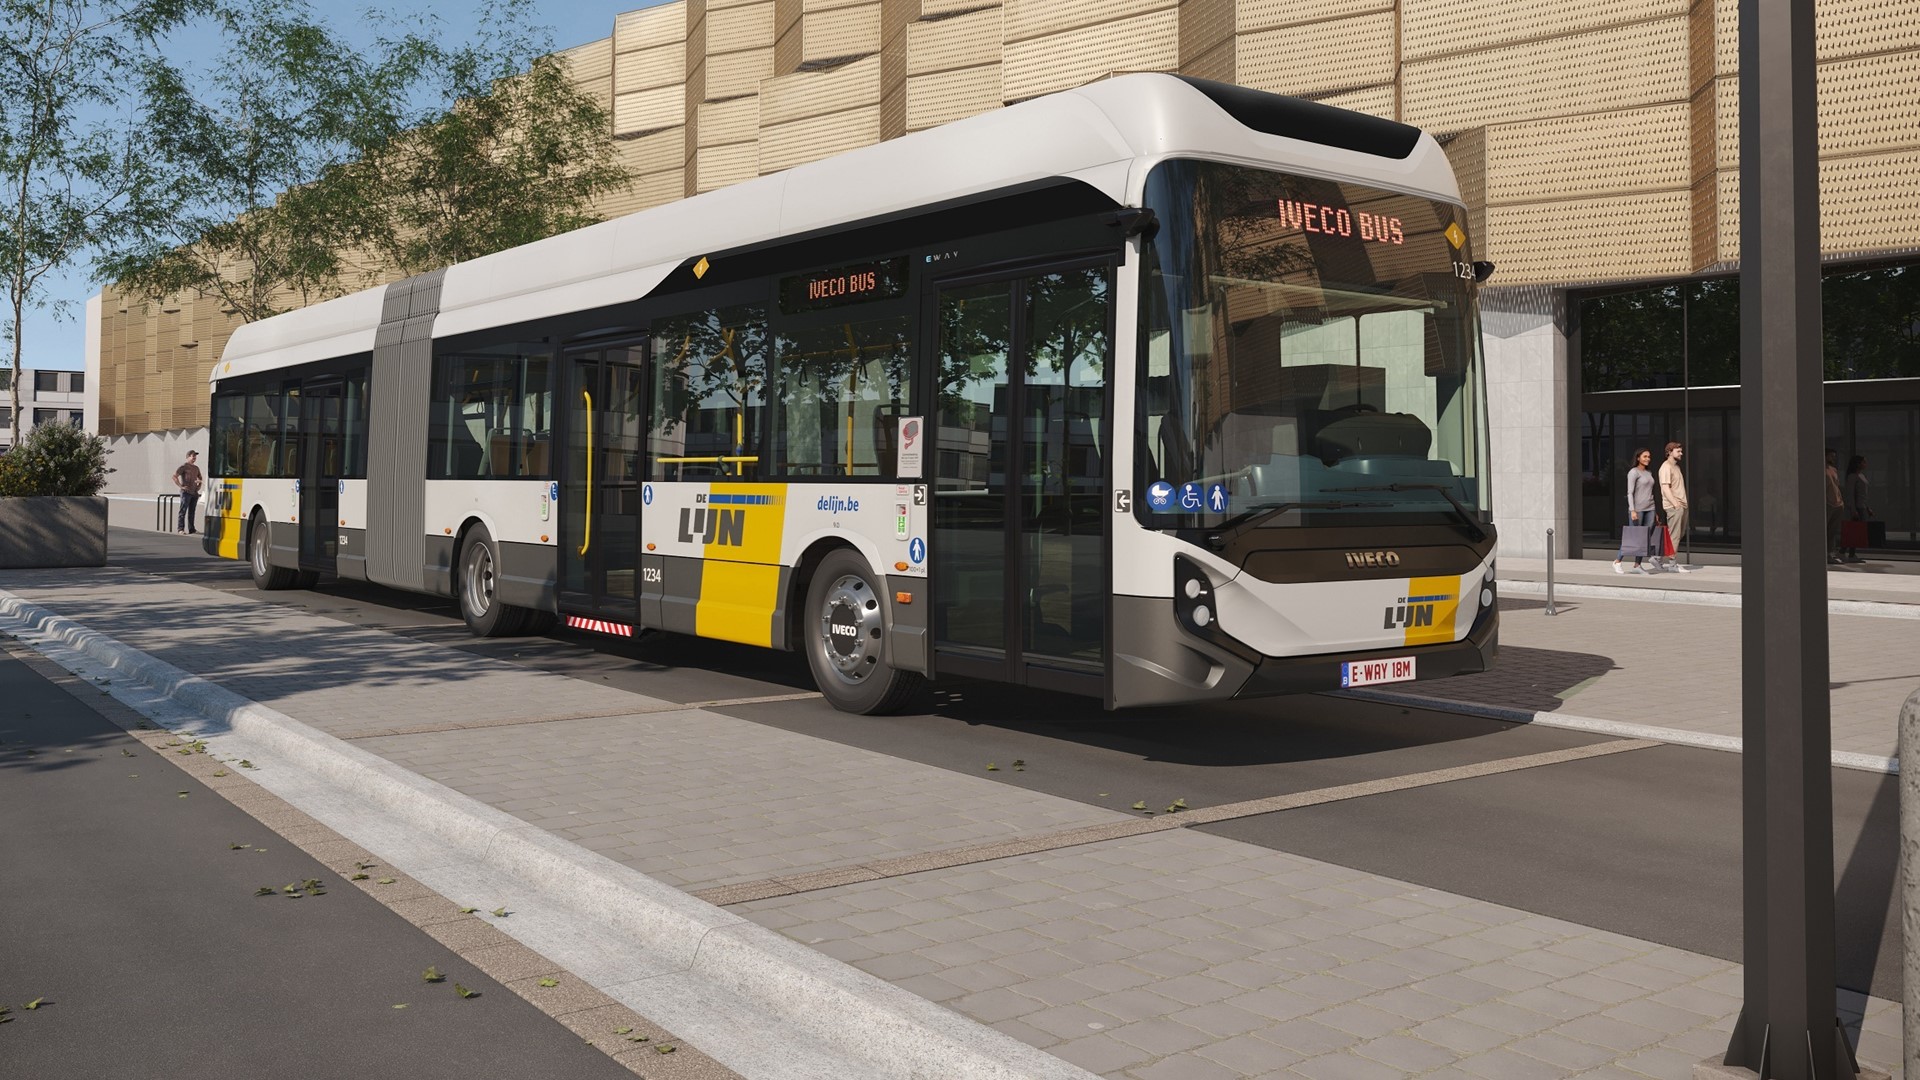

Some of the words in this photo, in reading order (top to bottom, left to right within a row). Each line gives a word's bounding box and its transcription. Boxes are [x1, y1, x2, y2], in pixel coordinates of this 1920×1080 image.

[1278, 199, 1351, 237] IVECO
[1358, 212, 1404, 245] BUS
[1453, 261, 1476, 280] 1234
[809, 277, 845, 300] IVECO
[850, 272, 876, 293] BUS
[696, 494, 707, 503] DE
[817, 495, 859, 515] delijn.be
[678, 507, 745, 547] LIJN
[1345, 551, 1400, 569] IVECO
[643, 567, 661, 582] 1234
[1383, 604, 1434, 630] LIJN
[832, 623, 857, 637] IVECO
[1392, 660, 1411, 678] 18M
